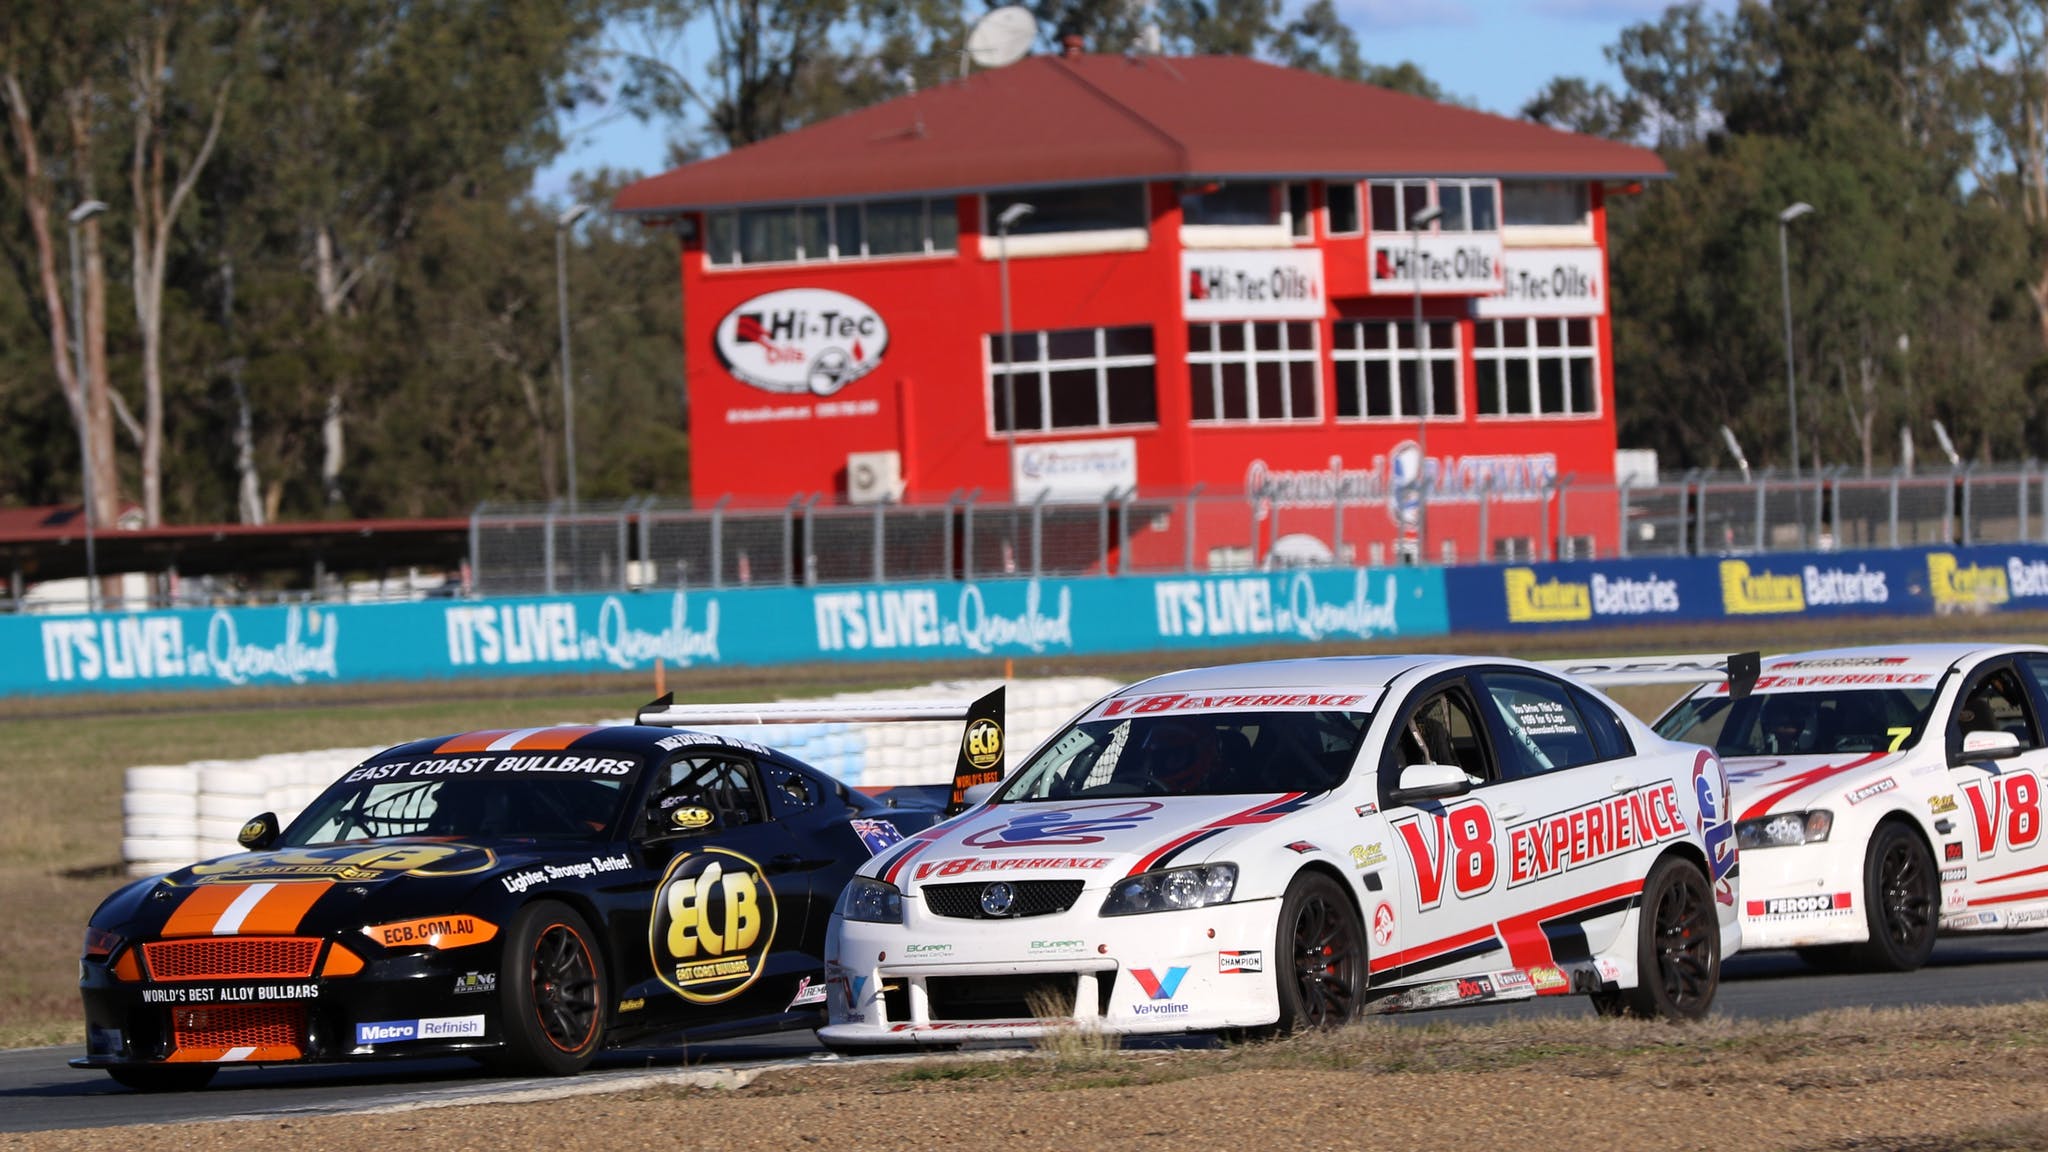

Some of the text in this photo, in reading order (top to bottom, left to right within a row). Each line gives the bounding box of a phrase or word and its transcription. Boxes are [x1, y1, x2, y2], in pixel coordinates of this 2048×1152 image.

[1394, 246, 1491, 280] HiTec Oils
[1271, 266, 1307, 299] Oils
[1503, 265, 1588, 298] i-Tec Oils
[770, 309, 876, 342] Hi-Tec
[1591, 572, 1679, 614] Batteries
[1803, 563, 1889, 606] Batteries
[1774, 673, 1934, 688] EXPERIENCE
[1102, 693, 1368, 717] V8 EXPERIENCE
[969, 723, 1000, 755] ECB
[1886, 726, 1912, 753] 7
[344, 756, 635, 783] EAST COAST BULLBARS
[1961, 769, 2043, 859] V8
[1395, 781, 1688, 910] V8 EXPERIENCE
[501, 853, 633, 893] Lighter, Stronger, Better!
[914, 857, 1114, 881] V8 EXPERIENCE
[667, 860, 761, 959] ECB
[1769, 895, 1830, 914] FERODO
[384, 919, 474, 945] ECB.COM.AU
[1220, 957, 1260, 966] CHAMPION
[142, 985, 319, 1003] WORLD'S BEST ALLOY BULLBARS
[1132, 1003, 1190, 1015] Valvoline
[361, 1020, 478, 1040] Metro Refinish
